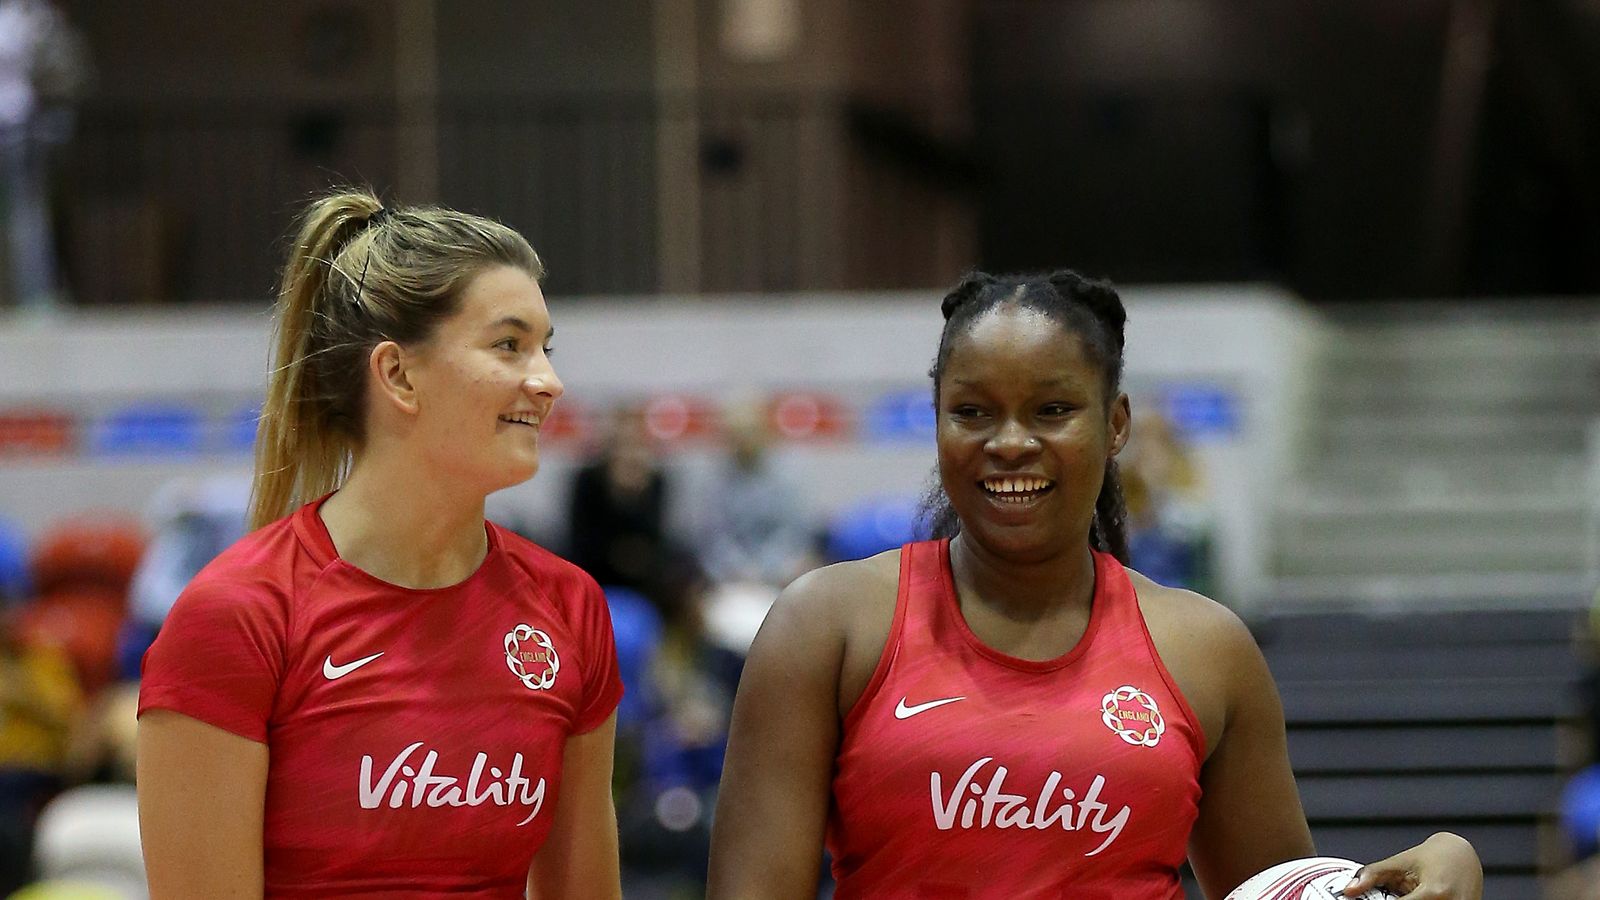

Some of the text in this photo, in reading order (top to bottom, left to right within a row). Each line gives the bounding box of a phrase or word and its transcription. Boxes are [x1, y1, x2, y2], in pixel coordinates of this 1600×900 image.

[1118, 709, 1150, 723] ENGLAND
[358, 741, 546, 828] Vitality
[930, 757, 1131, 857] Vitality
